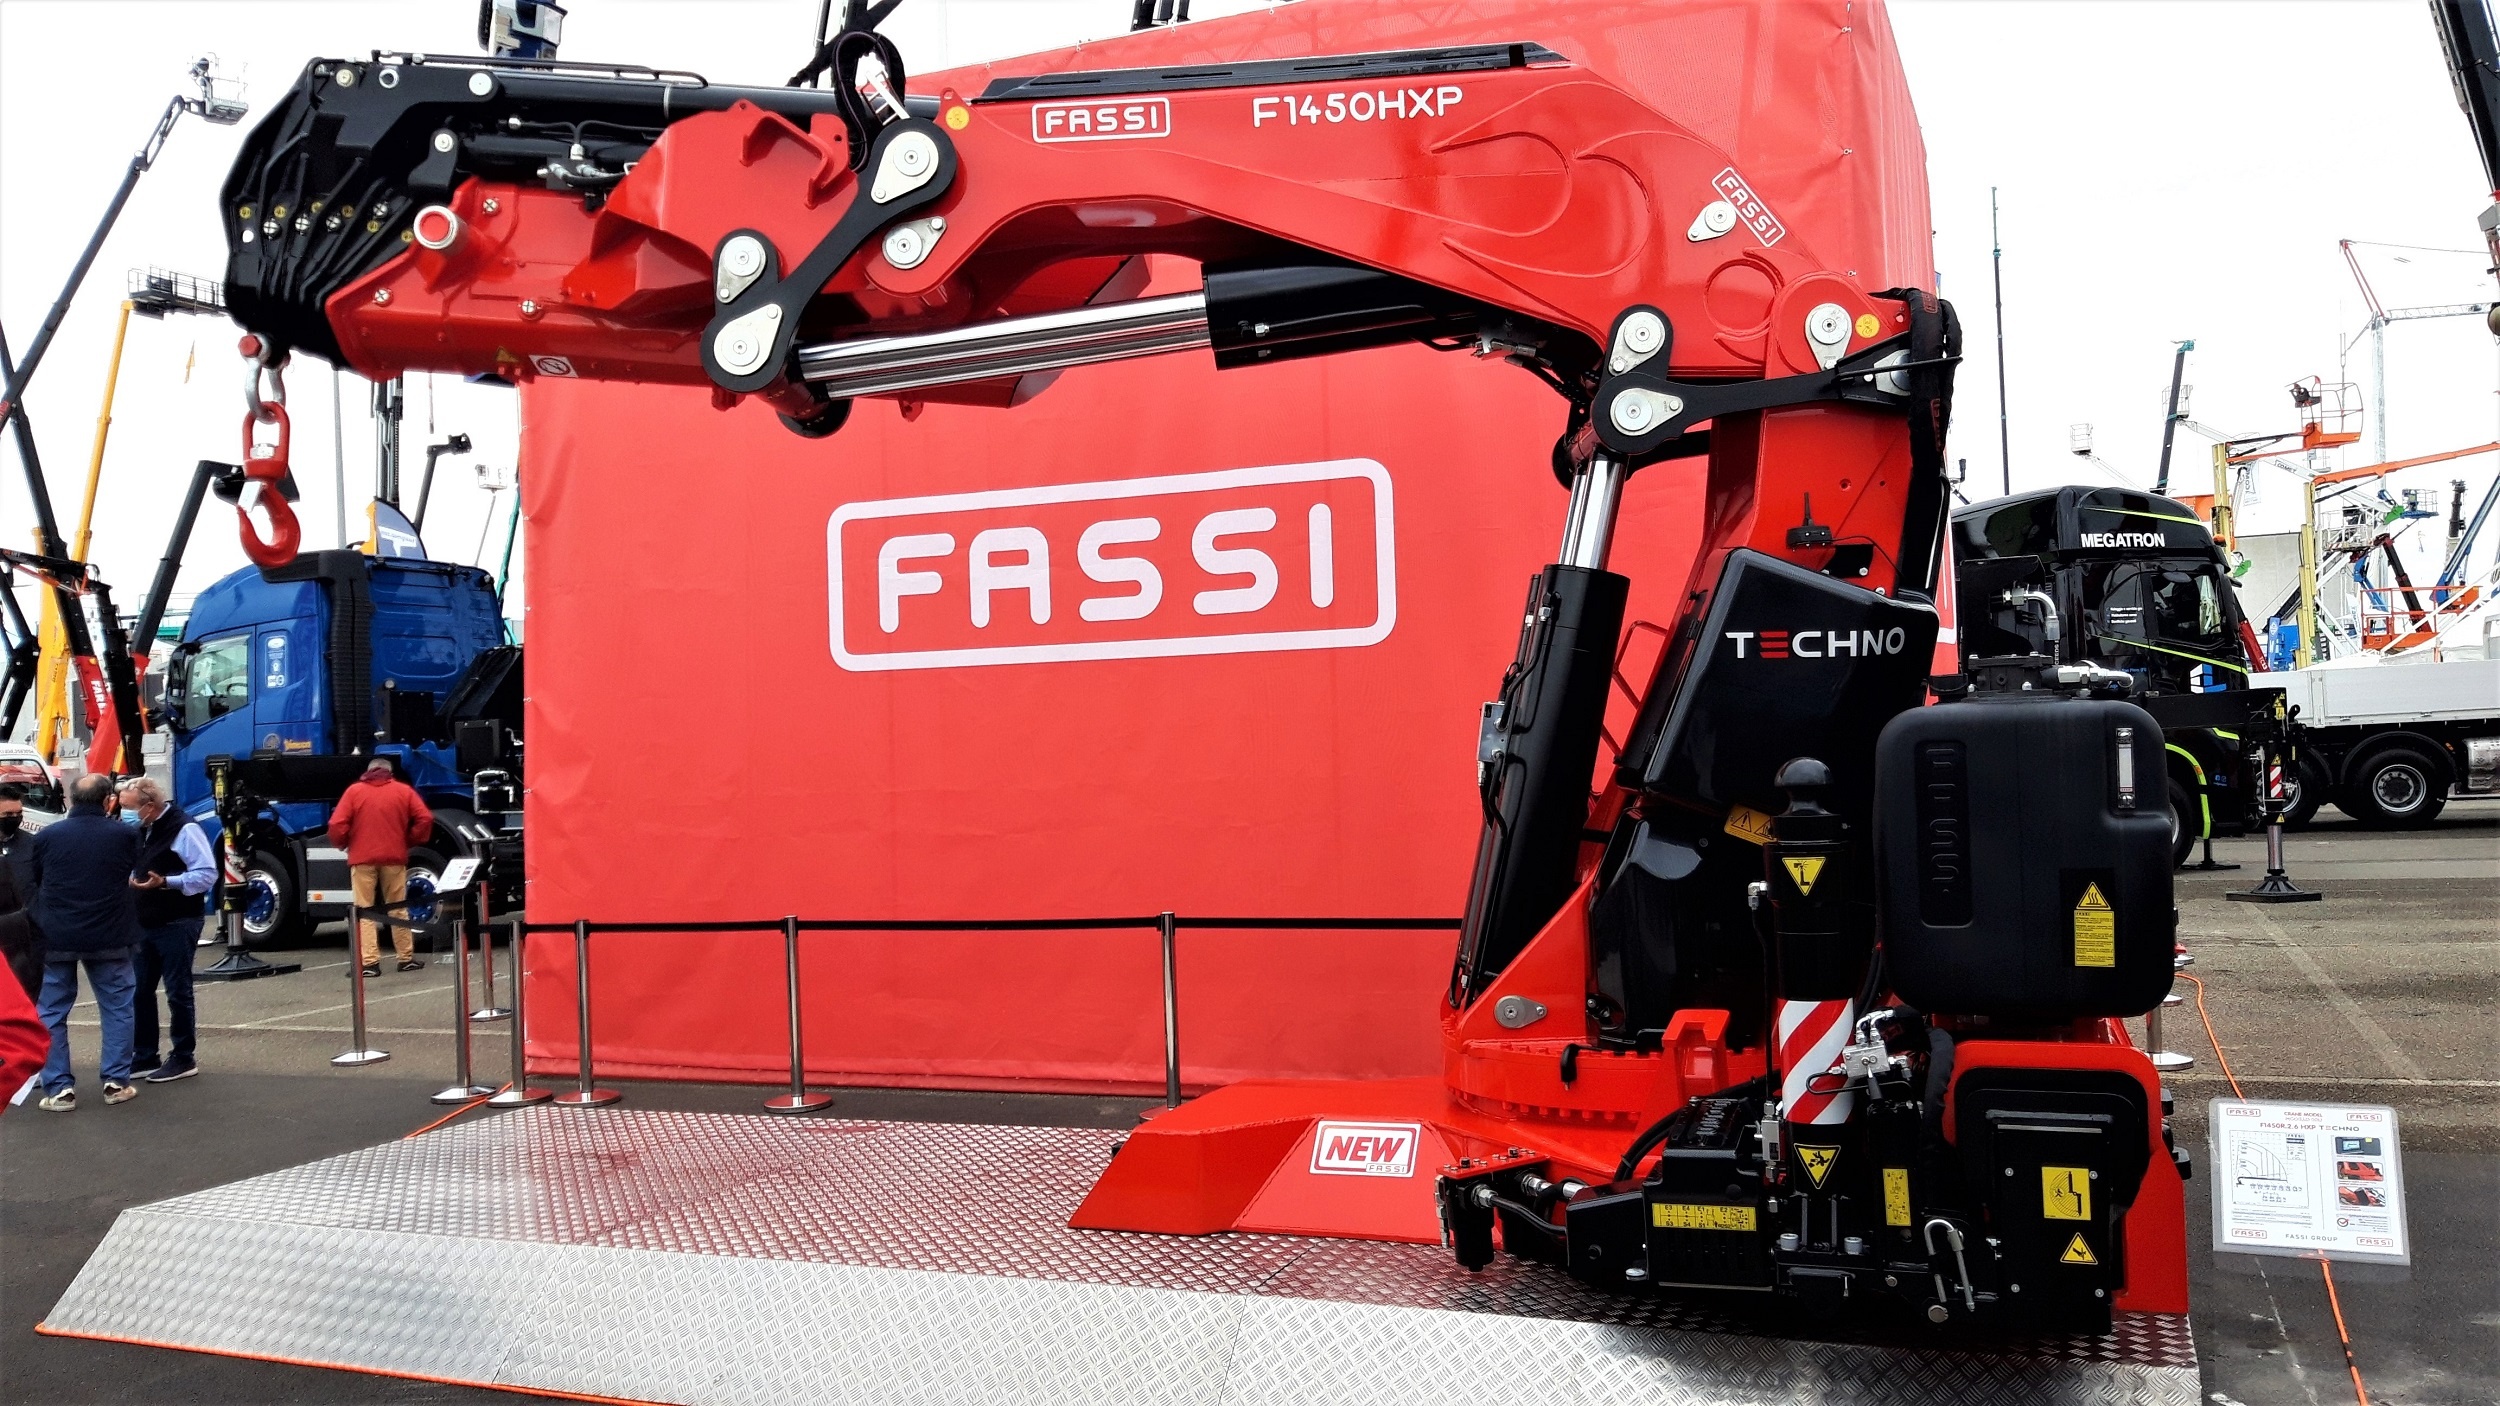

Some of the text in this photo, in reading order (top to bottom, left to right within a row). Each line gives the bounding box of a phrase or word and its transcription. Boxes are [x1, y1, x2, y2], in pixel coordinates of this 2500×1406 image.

[1045, 103, 1159, 134] FASSI
[1252, 86, 1464, 128] F1450HXP
[1720, 174, 1778, 239] FASSI
[2080, 532, 2165, 548] MEGATRON
[878, 502, 1334, 634] FASSI
[1725, 626, 1906, 659] TECHNO
[1325, 1135, 1406, 1163] NEW
[1368, 1164, 1406, 1174] FASSI
[2359, 1238, 2391, 1246] FASSI
